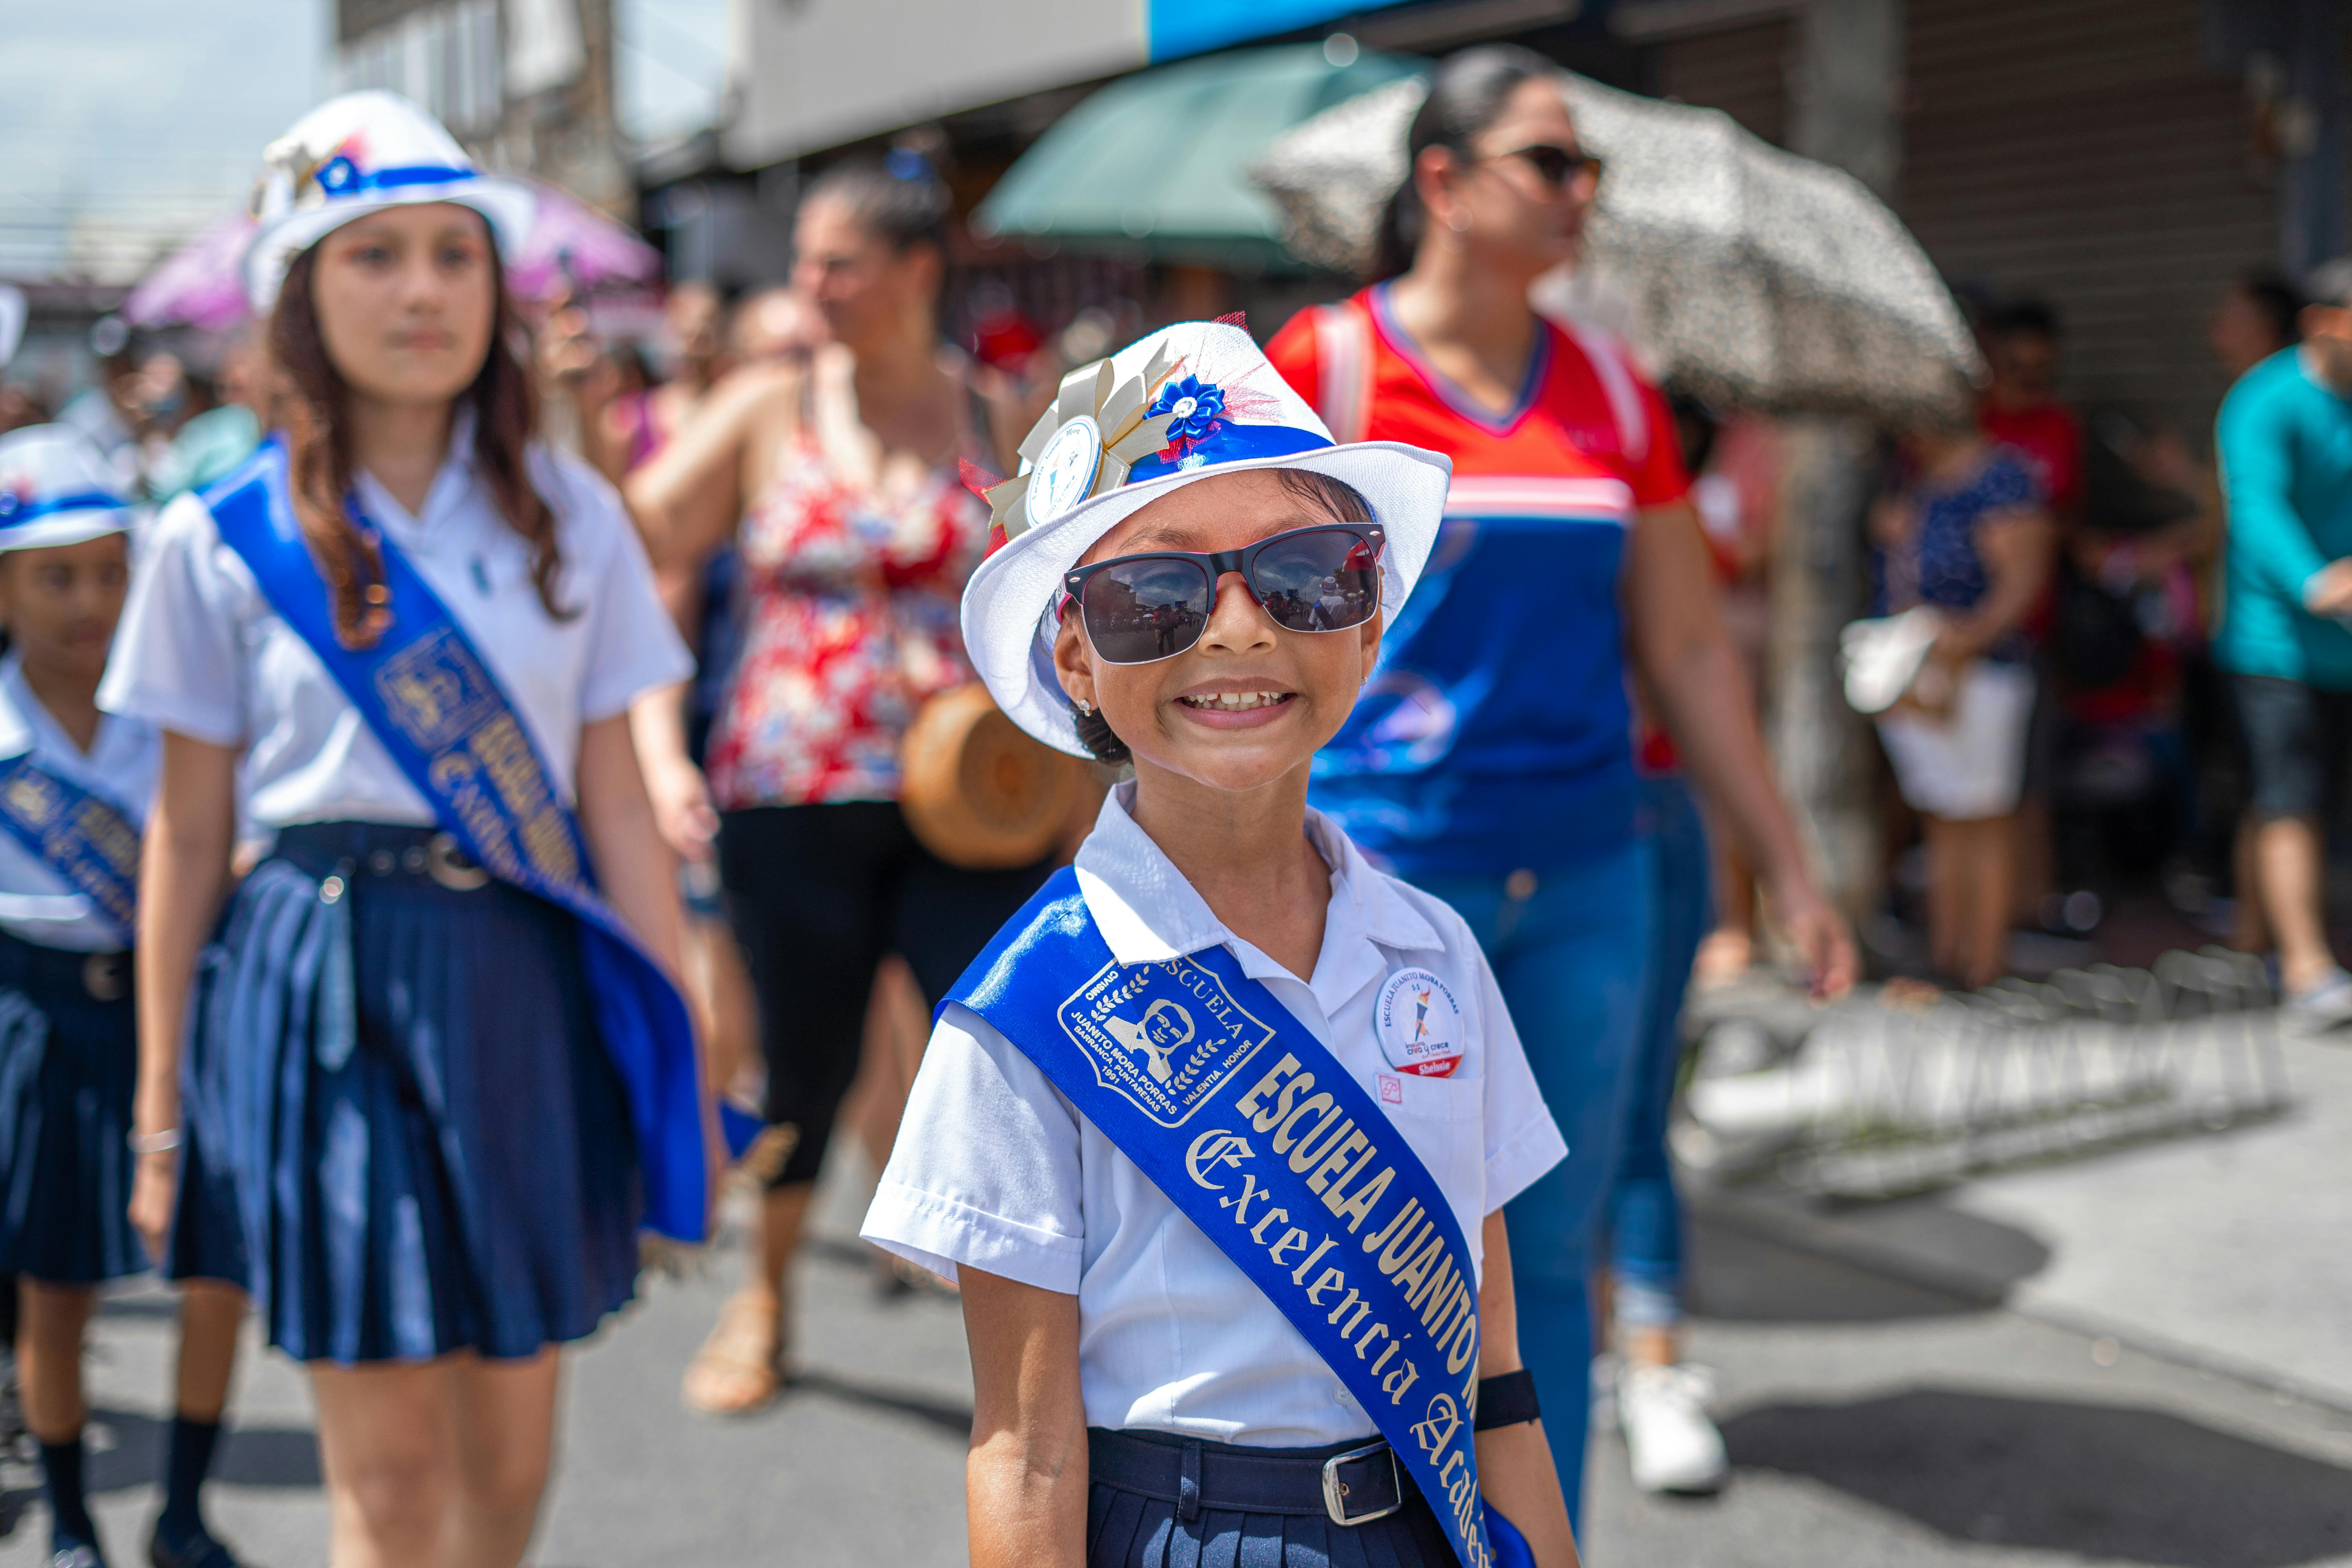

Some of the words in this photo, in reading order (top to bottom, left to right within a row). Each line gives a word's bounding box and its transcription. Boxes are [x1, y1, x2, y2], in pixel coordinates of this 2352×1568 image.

[1085, 971, 1118, 1000] CIVISMO
[1156, 959, 1243, 1039] SCUELA
[1383, 990, 1395, 1027] ESCUELA
[1391, 972, 1418, 993] JUANITO
[1419, 972, 1438, 987] MORA
[1439, 983, 1459, 1014] PORRAS
[1071, 1012, 1112, 1049] JUANITO
[1111, 1047, 1139, 1078] MORA
[1138, 1075, 1177, 1114] PORRAS
[1222, 1040, 1252, 1069] HONOR
[1424, 1045, 1429, 1055] y
[1430, 1042, 1449, 1050] crece
[1102, 1065, 1120, 1084] 1991
[1114, 1064, 1161, 1112] PUNTARENAS
[1236, 1053, 1396, 1234] ESCUELA
[1363, 1197, 1476, 1375] JUANITO
[1185, 1129, 1420, 1405] Excelencia
